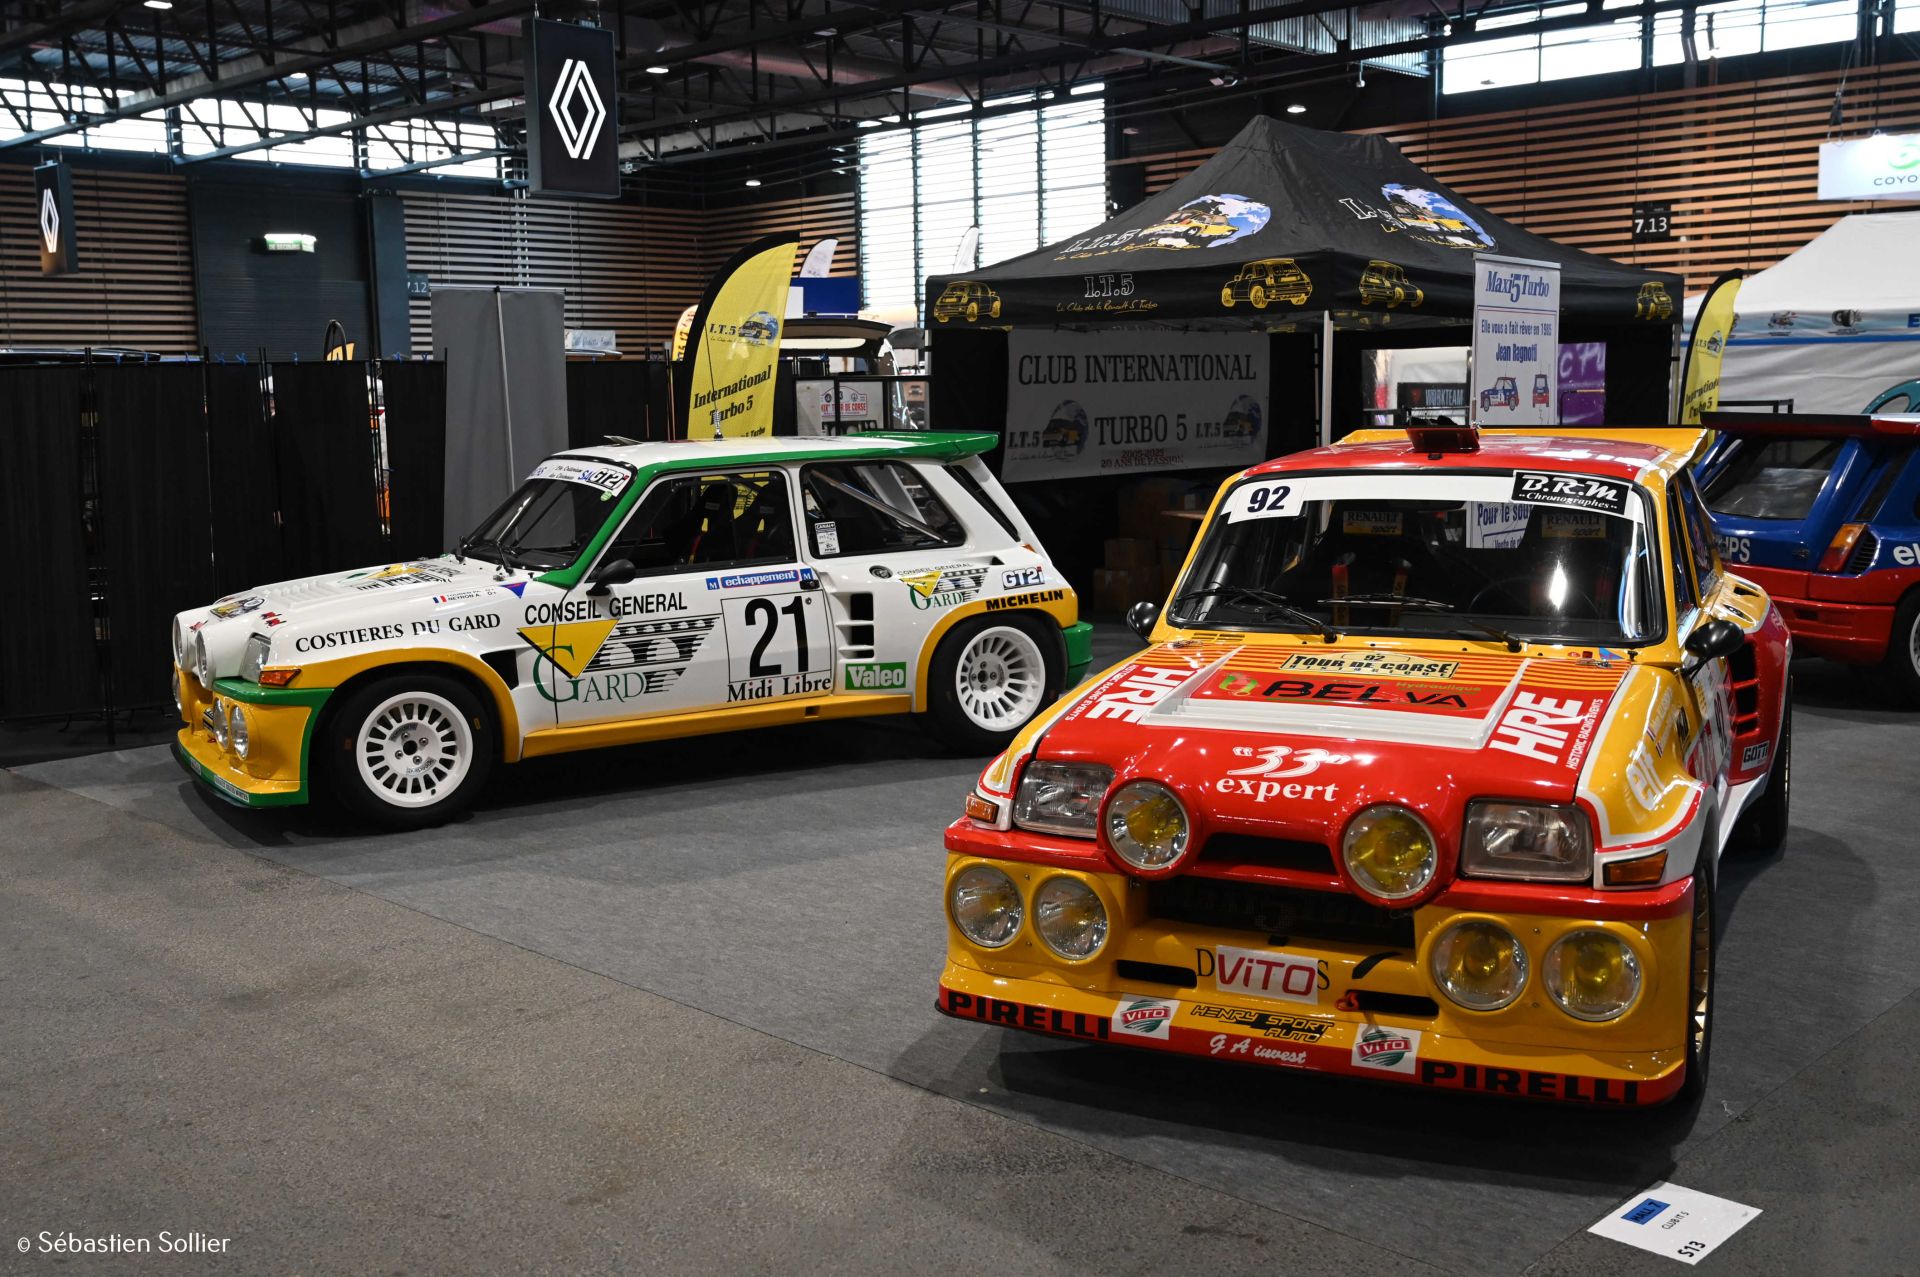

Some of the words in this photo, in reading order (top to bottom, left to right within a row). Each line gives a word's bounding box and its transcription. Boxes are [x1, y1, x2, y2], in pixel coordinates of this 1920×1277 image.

[1873, 174, 1919, 186] COYO
[1634, 216, 1668, 234] 7.13
[406, 281, 428, 293] .12
[1084, 273, 1135, 298] I.T.5
[709, 323, 736, 336] I.T.5
[1491, 323, 1504, 335] vous
[1509, 320, 1519, 335] fait
[1533, 325, 1540, 336] en
[1496, 343, 1511, 362] Jean
[1018, 354, 1077, 385] CLUB
[1084, 354, 1257, 383] INTERNATIONAL
[693, 364, 772, 409] International
[709, 400, 745, 425] Turbo
[746, 395, 754, 411] 5
[1007, 431, 1040, 449] I.T.5
[1094, 414, 1168, 446] TURBO
[1176, 414, 1188, 441] 5
[1195, 422, 1221, 439] I.T.5
[1134, 457, 1145, 466] DE
[1146, 455, 1184, 466] PASSION
[1247, 485, 1291, 513] 92
[1347, 511, 1398, 522] RENAULT
[1477, 502, 1498, 526] Pour
[1501, 502, 1510, 522] le
[1546, 514, 1601, 526] RENAULT
[897, 568, 934, 576] CONSEIL
[934, 562, 973, 571] GENERAL
[709, 582, 718, 590] M
[725, 571, 797, 587] echappement
[803, 572, 812, 580] M
[525, 600, 601, 625] CONSEIL
[609, 592, 688, 617] GENERAL
[986, 590, 1064, 611] MICHELIN
[295, 623, 404, 653] COSTIERES
[411, 619, 440, 636] DU
[448, 613, 501, 632] GARD
[744, 595, 809, 678] 21
[1293, 655, 1345, 667] TOUR
[1349, 661, 1376, 669] DE
[1380, 662, 1453, 673] CORSE
[1363, 654, 1386, 662] 92
[532, 644, 645, 703] GARD
[848, 665, 905, 689] Valeo
[727, 680, 773, 703] Midi
[783, 674, 831, 696] Libre
[1084, 666, 1197, 724] HRE
[1090, 680, 1114, 701] RACING
[1262, 680, 1468, 709] BELVA
[1064, 700, 1093, 721] EVENTS
[1488, 691, 1583, 765] HRE
[1566, 738, 1587, 769] HISTORIC
[1578, 717, 1595, 741] RACING
[1216, 778, 1340, 803] expert
[947, 990, 1109, 1040] PIRELLI
[1191, 1005, 1259, 1022] HENRY
[1266, 1015, 1335, 1032] SPORT
[1264, 1026, 1321, 1043] AUTO
[1253, 1044, 1307, 1063] invest
[1421, 1061, 1639, 1105] PIRELLI
[1630, 1208, 1655, 1221] HALL
[1661, 1217, 1680, 1230] CLUB
[1677, 1240, 1706, 1258] S13
